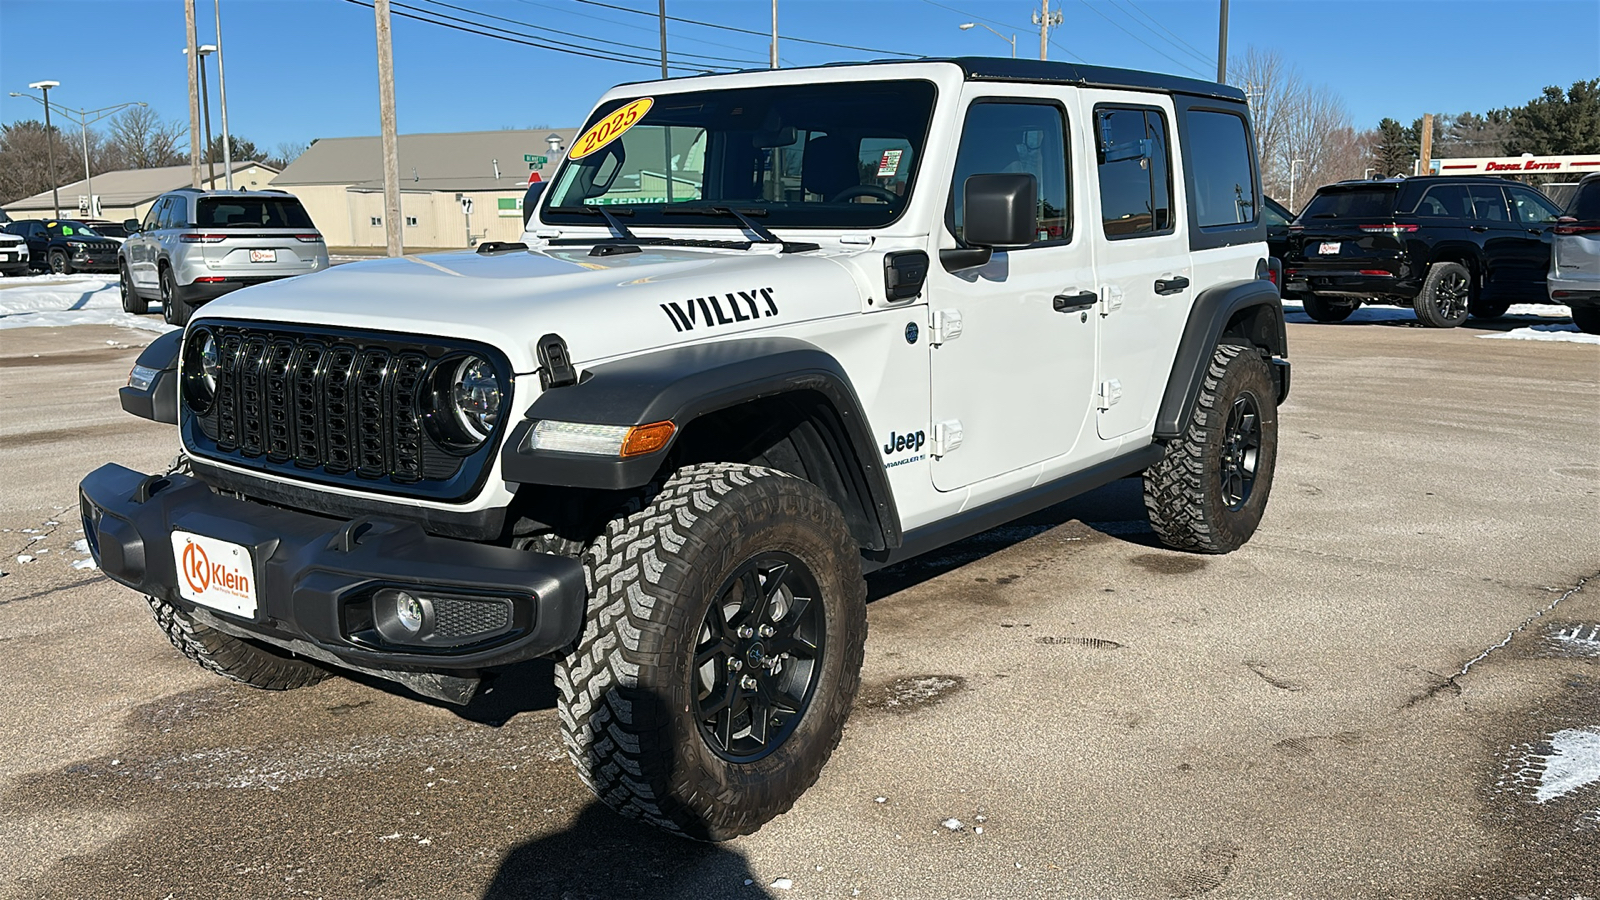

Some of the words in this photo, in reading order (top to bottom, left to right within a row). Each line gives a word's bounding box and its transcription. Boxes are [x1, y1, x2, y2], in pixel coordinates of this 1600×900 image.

[582, 103, 639, 154] 2025
[611, 197, 669, 205] SERVIC
[659, 287, 779, 333] WILLYS
[883, 430, 926, 455] Jeep
[211, 562, 249, 593] Klein
